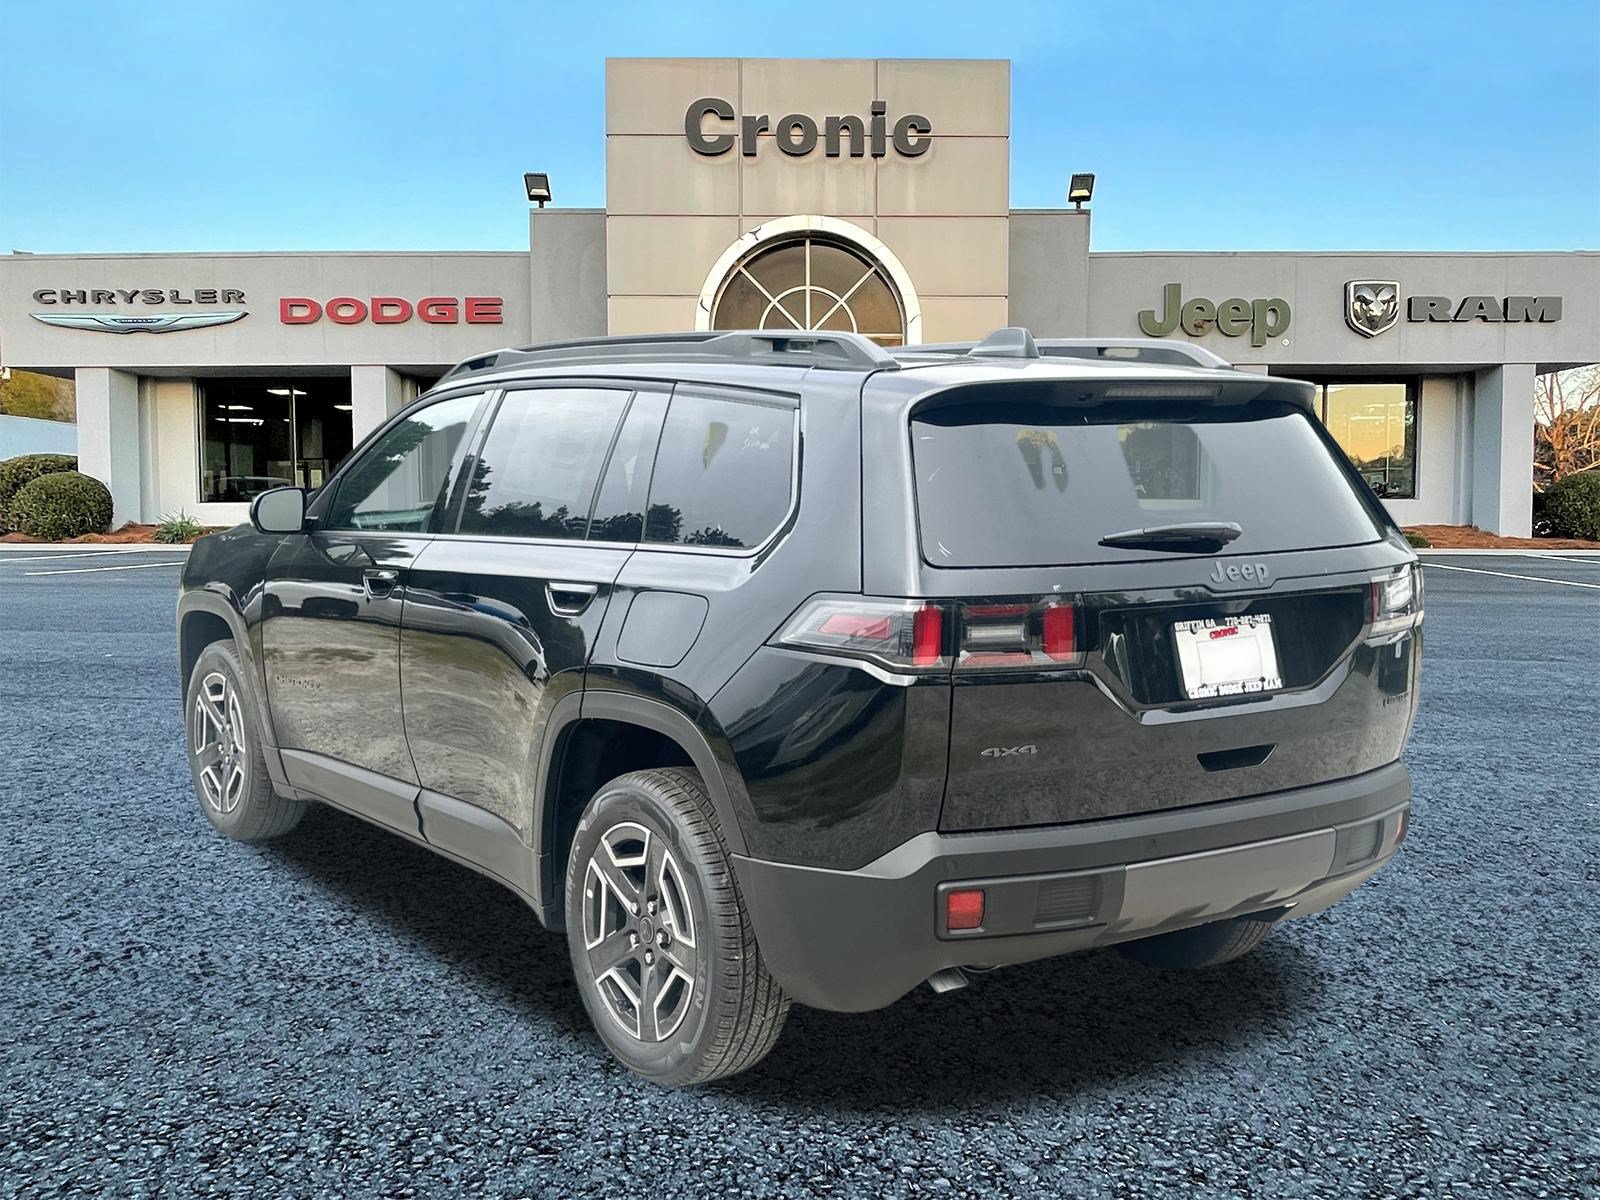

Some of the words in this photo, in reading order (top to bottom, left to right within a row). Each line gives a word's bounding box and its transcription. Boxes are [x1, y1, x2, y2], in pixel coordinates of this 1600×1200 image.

[685, 97, 932, 159] Cronic
[32, 289, 247, 304] CHRYSLER
[279, 296, 504, 324] DODGE
[1407, 296, 1563, 322] RAM
[1138, 283, 1291, 347] Jeep
[1209, 561, 1270, 584] Jeep
